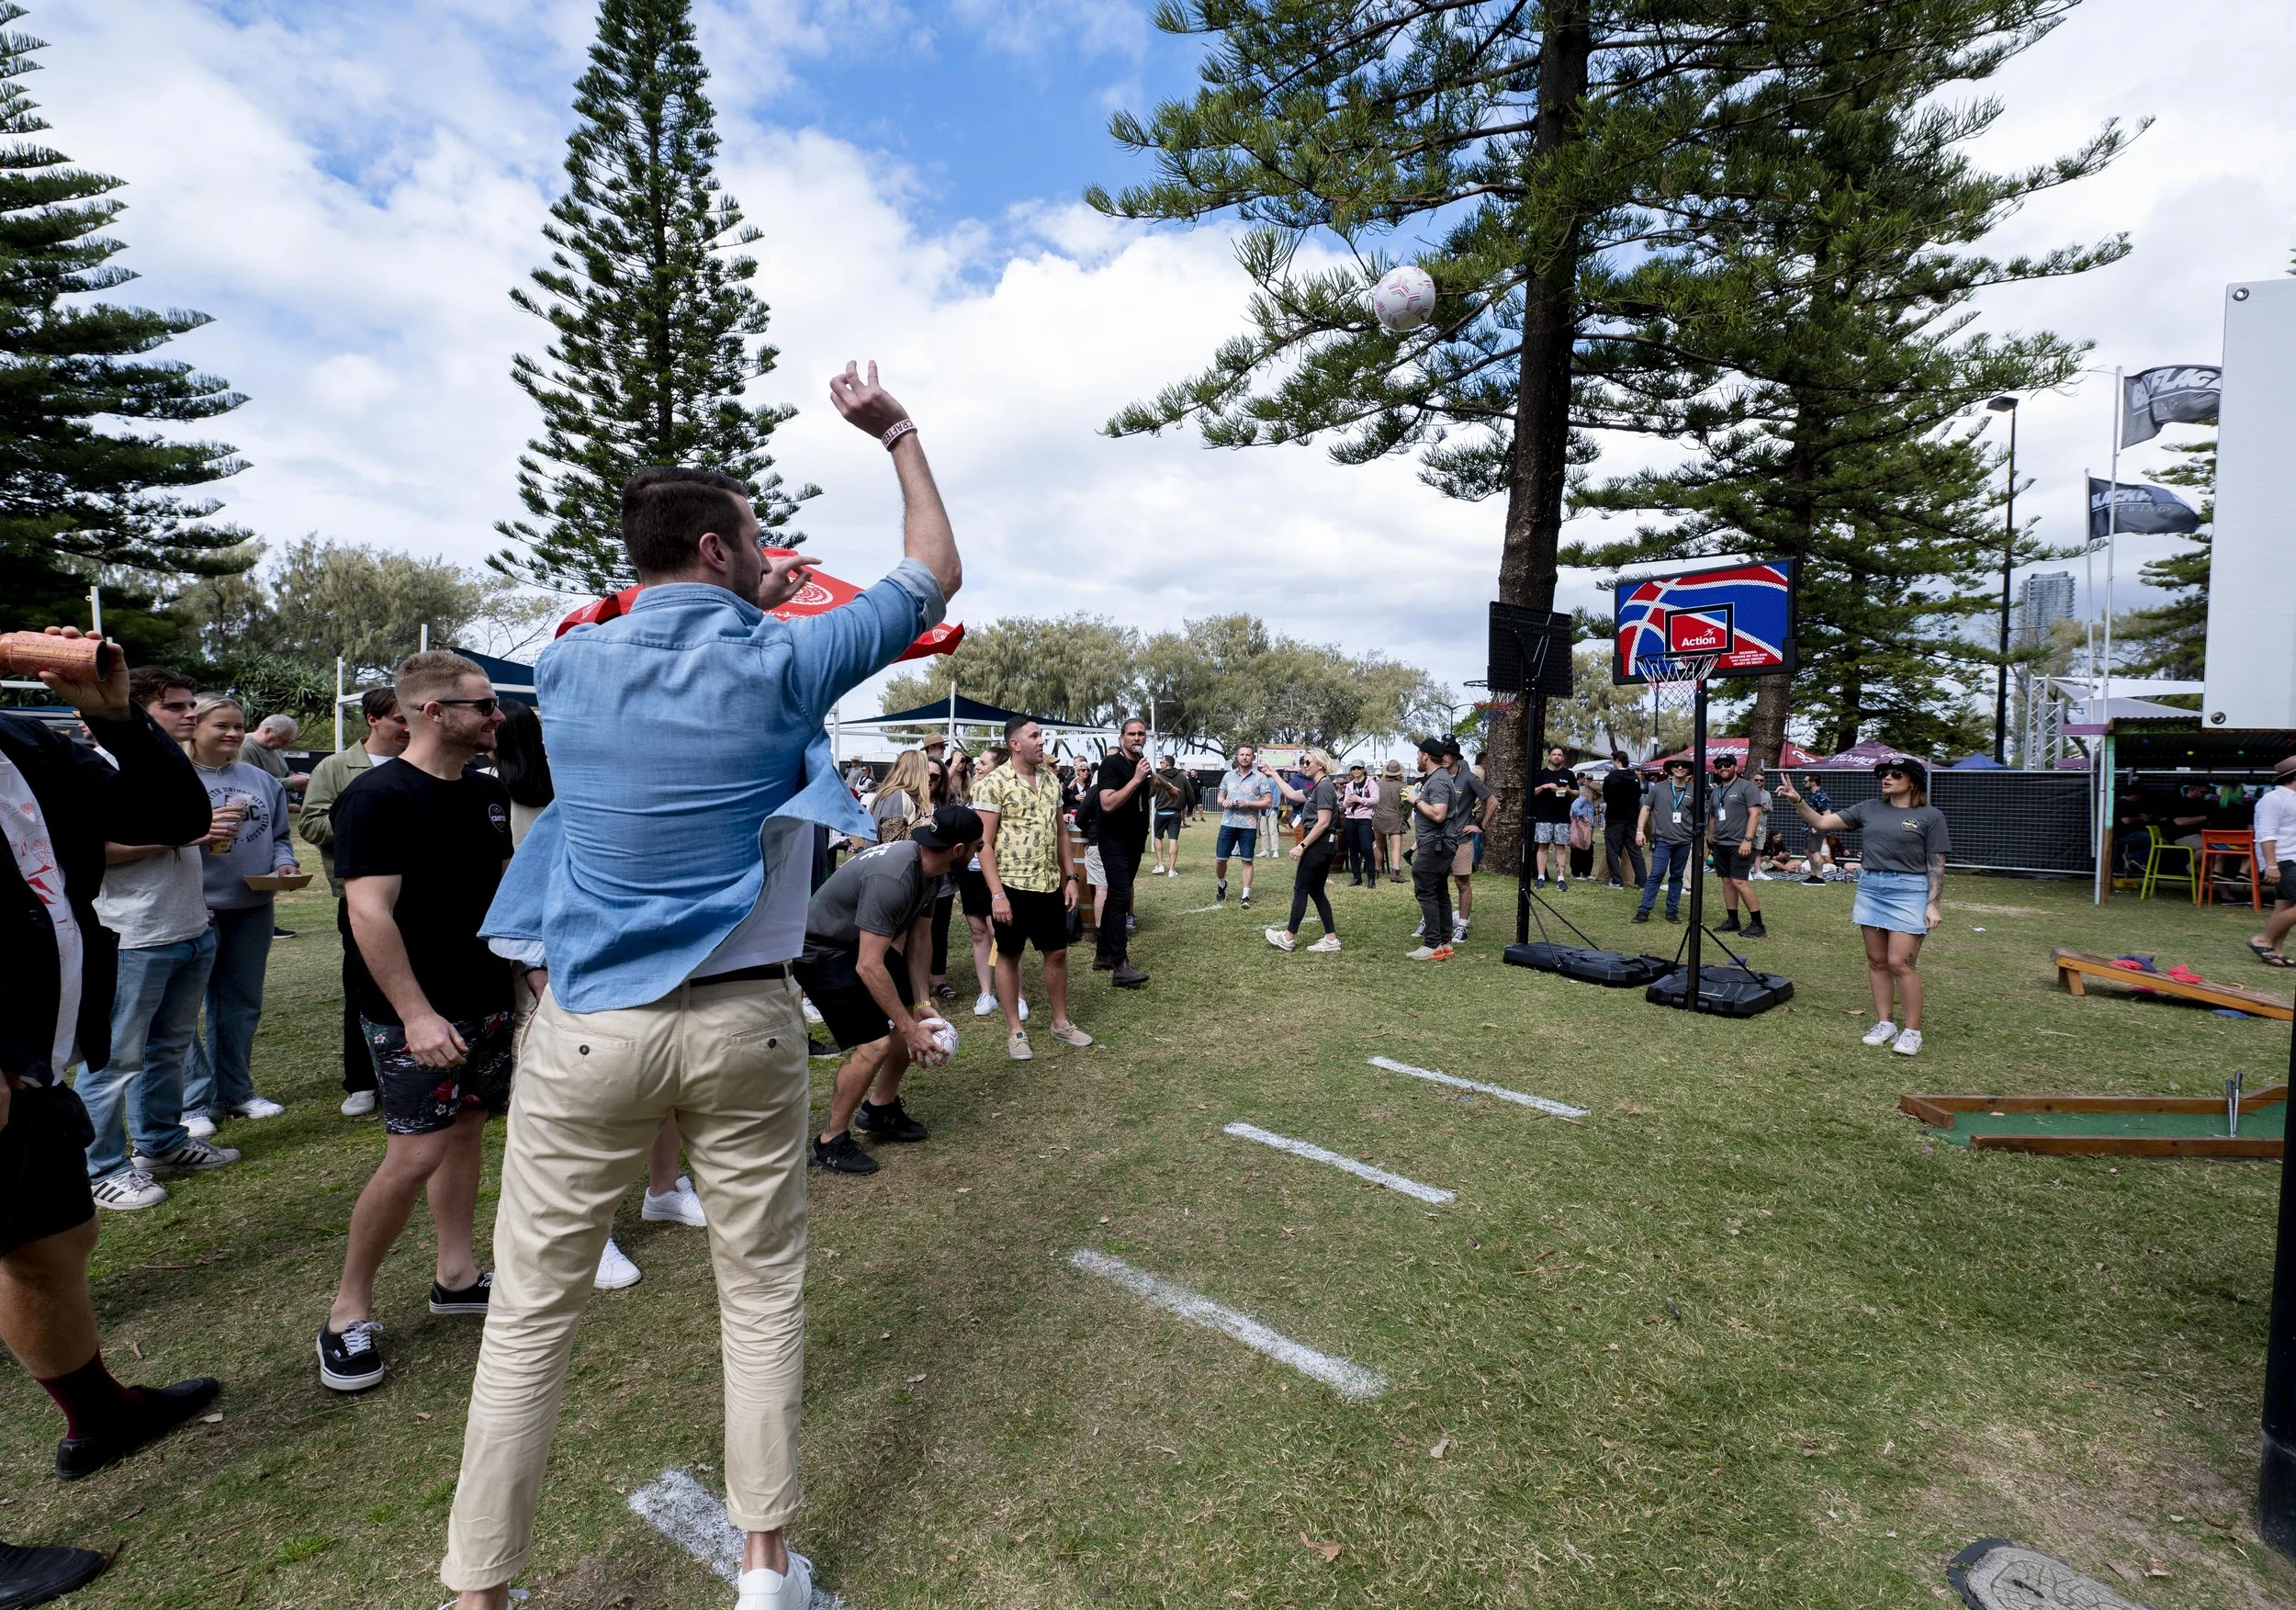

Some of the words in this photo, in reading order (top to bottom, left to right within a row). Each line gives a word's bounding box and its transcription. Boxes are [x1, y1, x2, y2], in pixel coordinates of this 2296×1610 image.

[883, 420, 913, 445] CRAFTED
[1682, 636, 1716, 647] Action
[222, 786, 267, 809] UNIVSITY
[245, 813, 270, 844] AUSTRALIA
